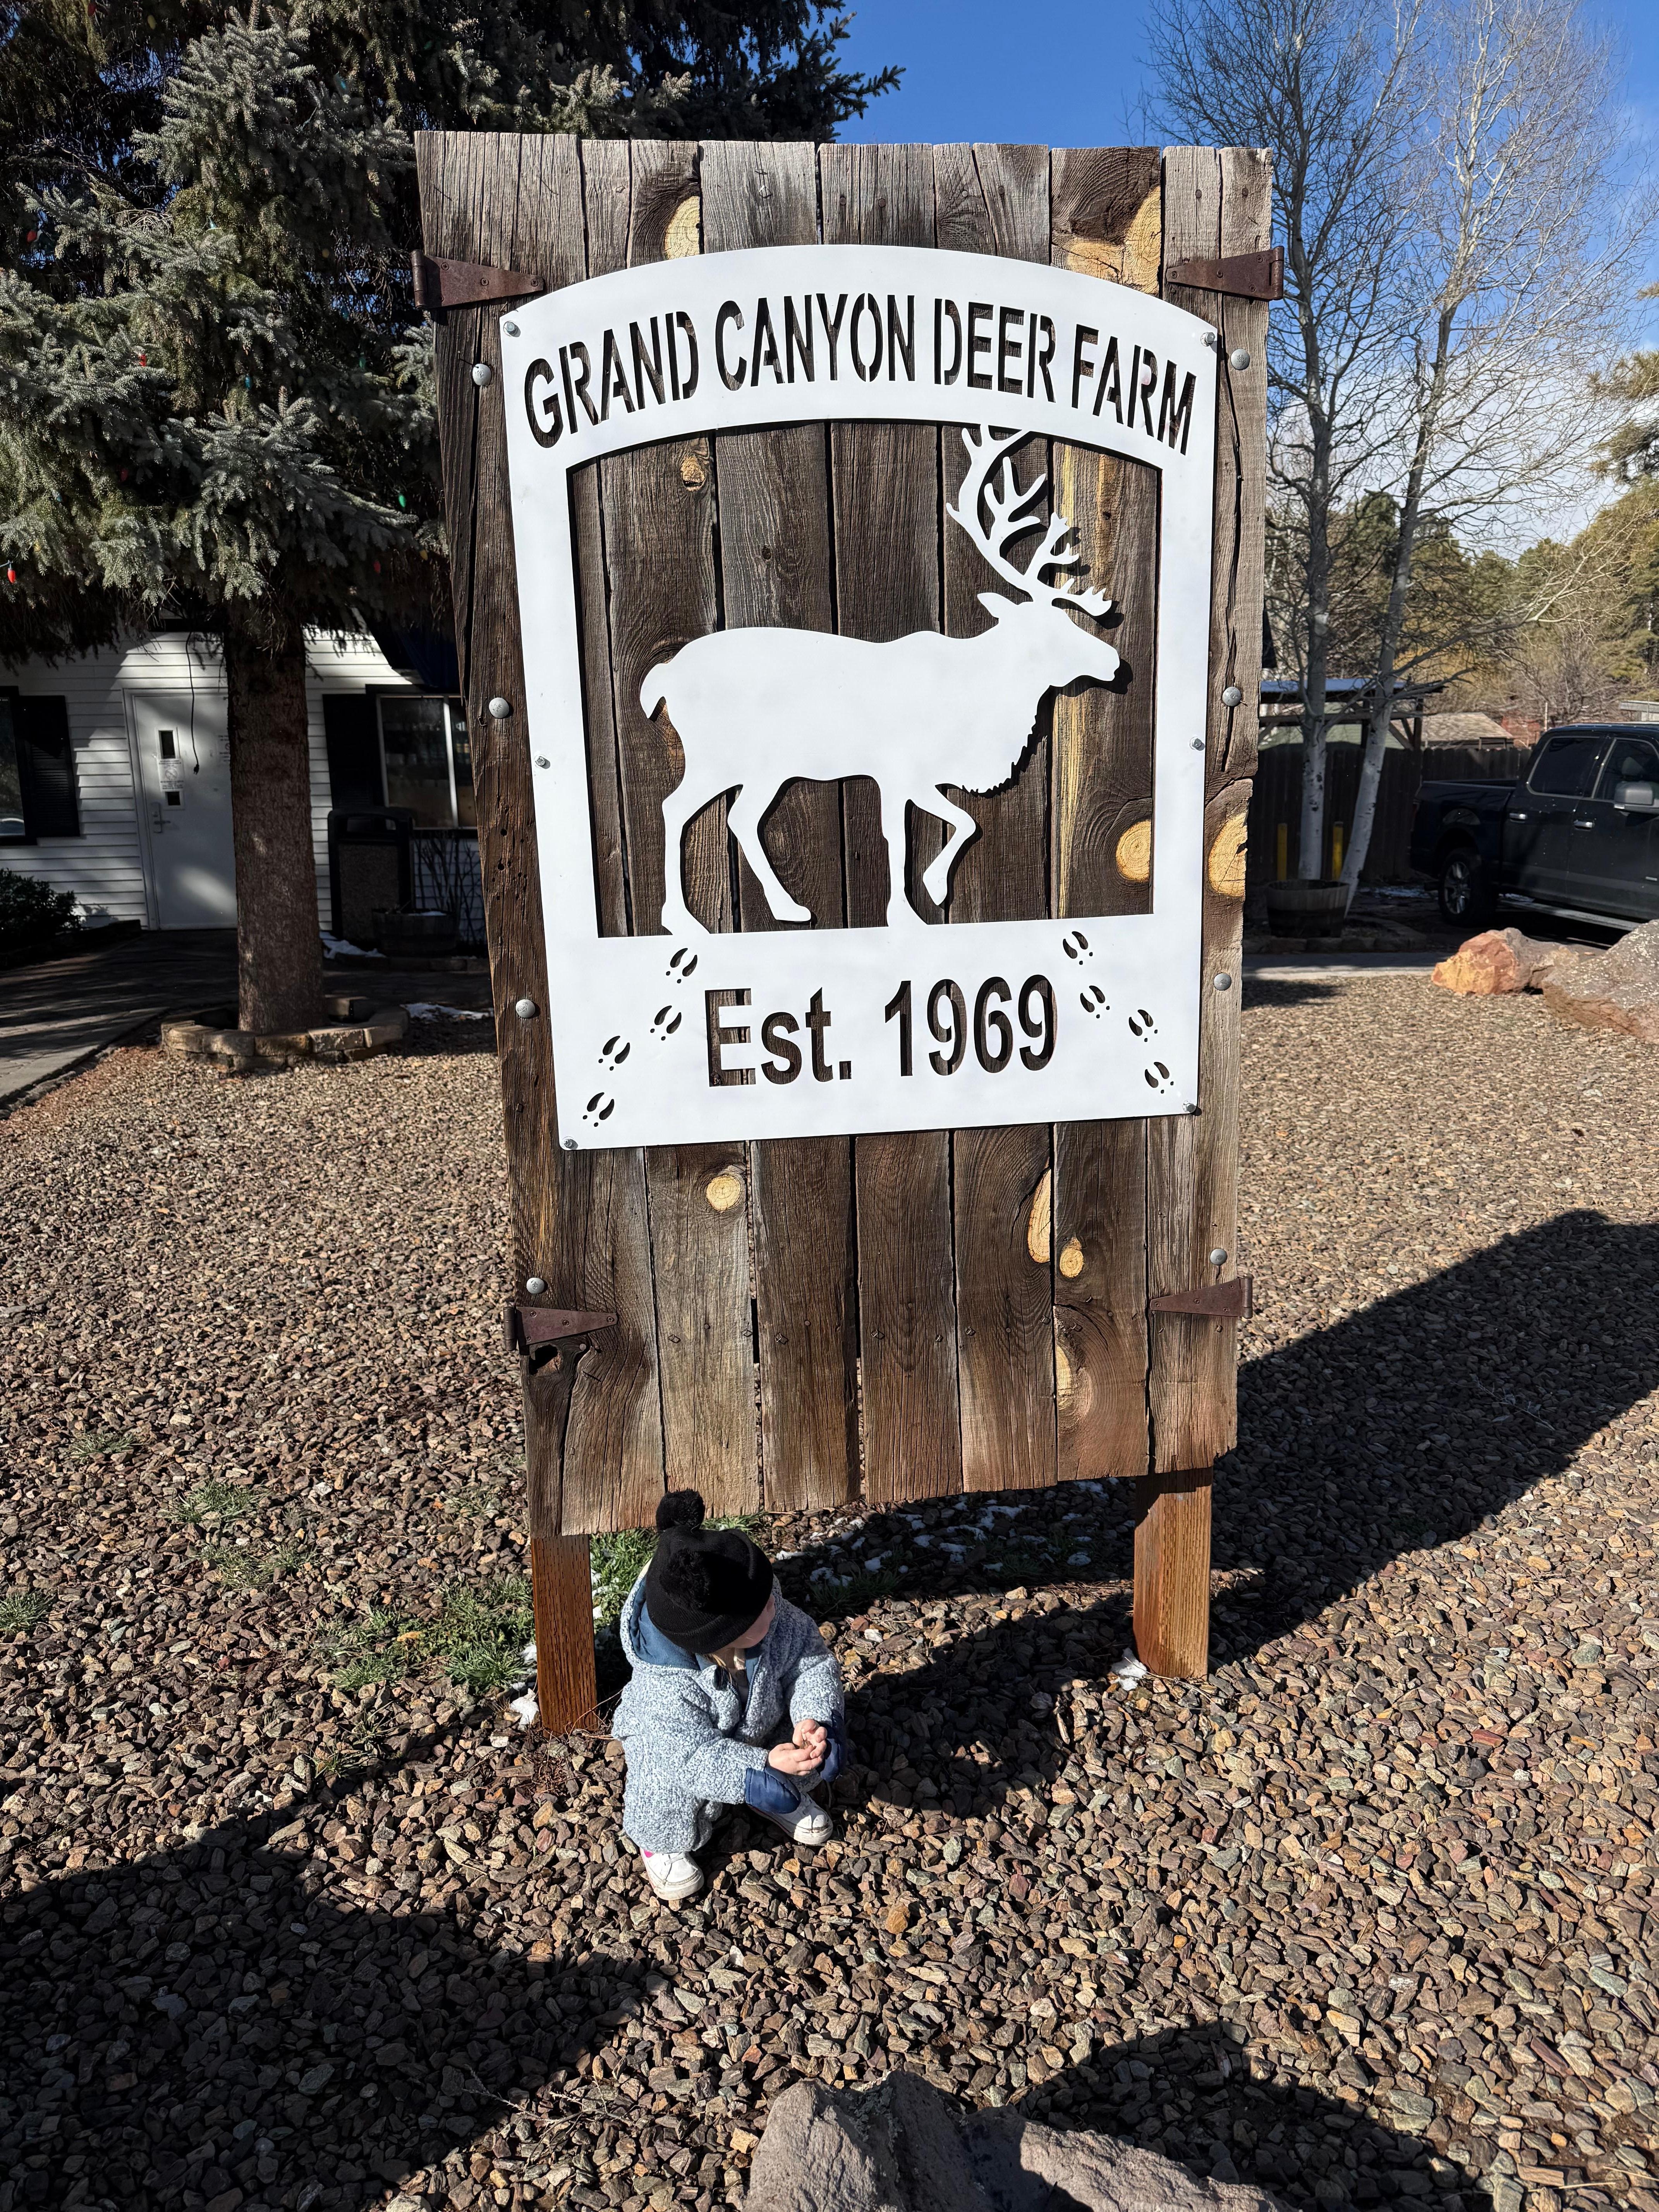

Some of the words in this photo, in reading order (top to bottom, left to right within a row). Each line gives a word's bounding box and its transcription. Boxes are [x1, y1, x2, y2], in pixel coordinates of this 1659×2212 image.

[524, 311, 699, 448] GRAND
[715, 293, 915, 391] CANYON
[934, 299, 1056, 403] DEER
[1072, 324, 1197, 455] FARM
[705, 987, 852, 1087] Est.
[884, 975, 1057, 1077] 1969
